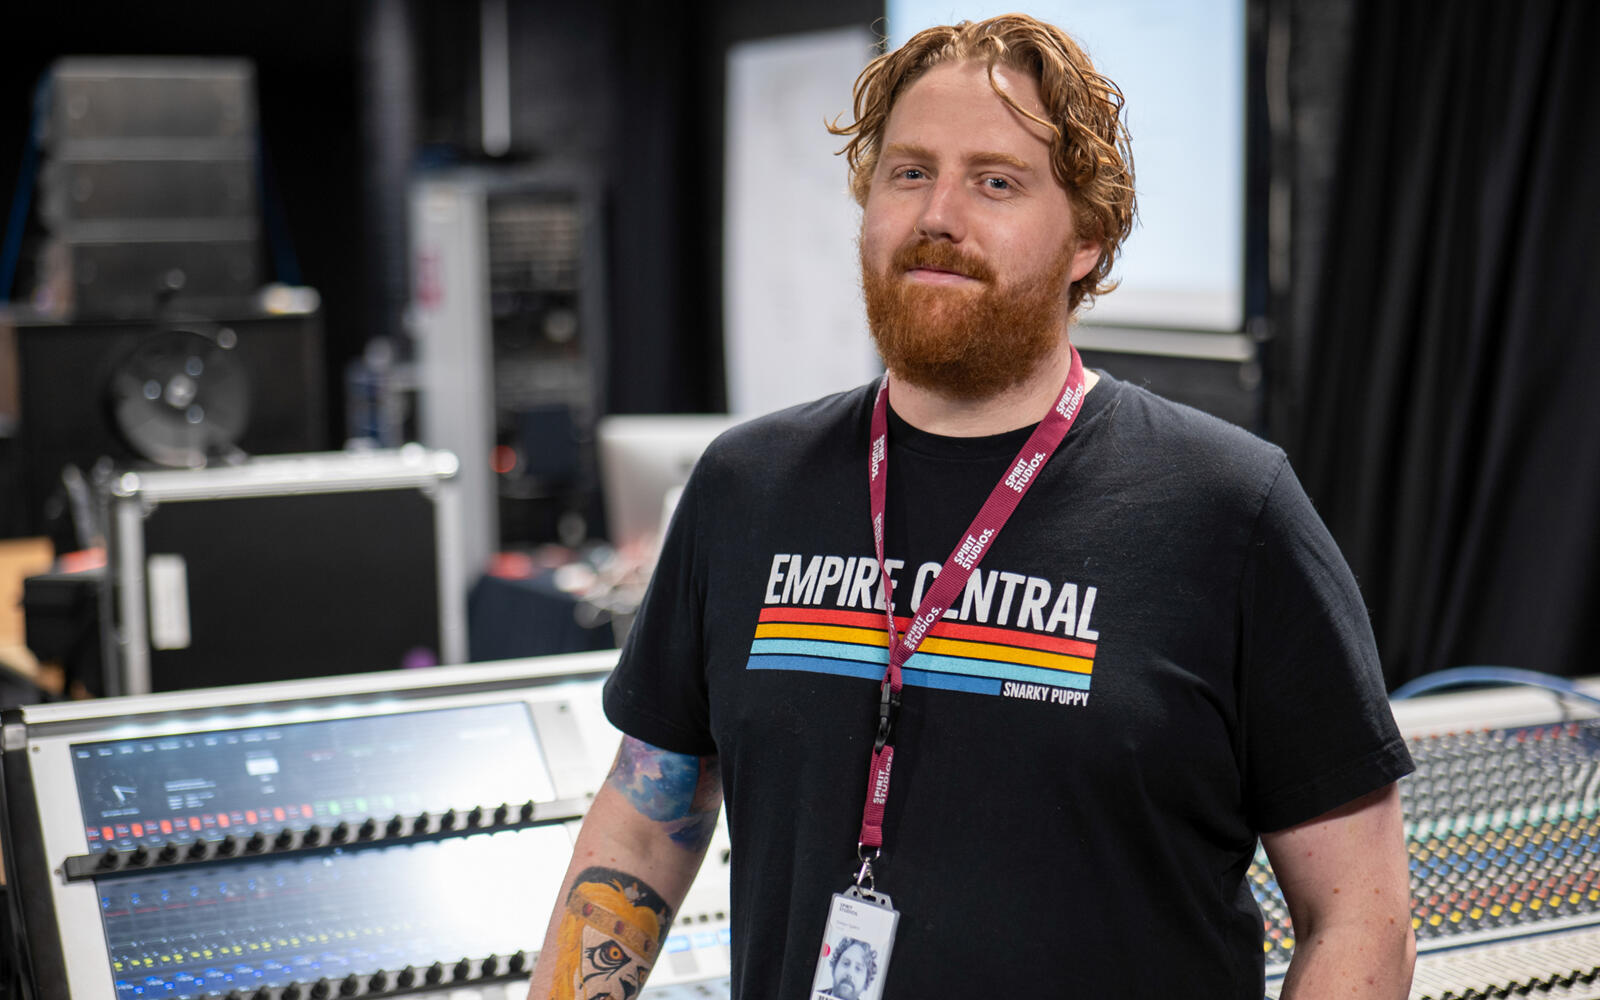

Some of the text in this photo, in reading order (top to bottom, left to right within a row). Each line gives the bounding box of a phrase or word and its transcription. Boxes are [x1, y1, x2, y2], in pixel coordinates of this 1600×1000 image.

[1056, 386, 1074, 415] SPIRIT
[1005, 458, 1028, 488] SPIRIT
[1013, 452, 1046, 493] STUDIOS.
[954, 534, 977, 565] SPIRIT
[962, 528, 995, 570] STUDIOS.
[764, 553, 905, 612] EMPIRE
[910, 561, 1100, 641] CNTRAL
[904, 615, 924, 647] SPIRIT
[908, 606, 942, 651] STUDIOS.
[1003, 681, 1089, 707] SNARKY PUPPY
[873, 769, 885, 804] SPIRIT
